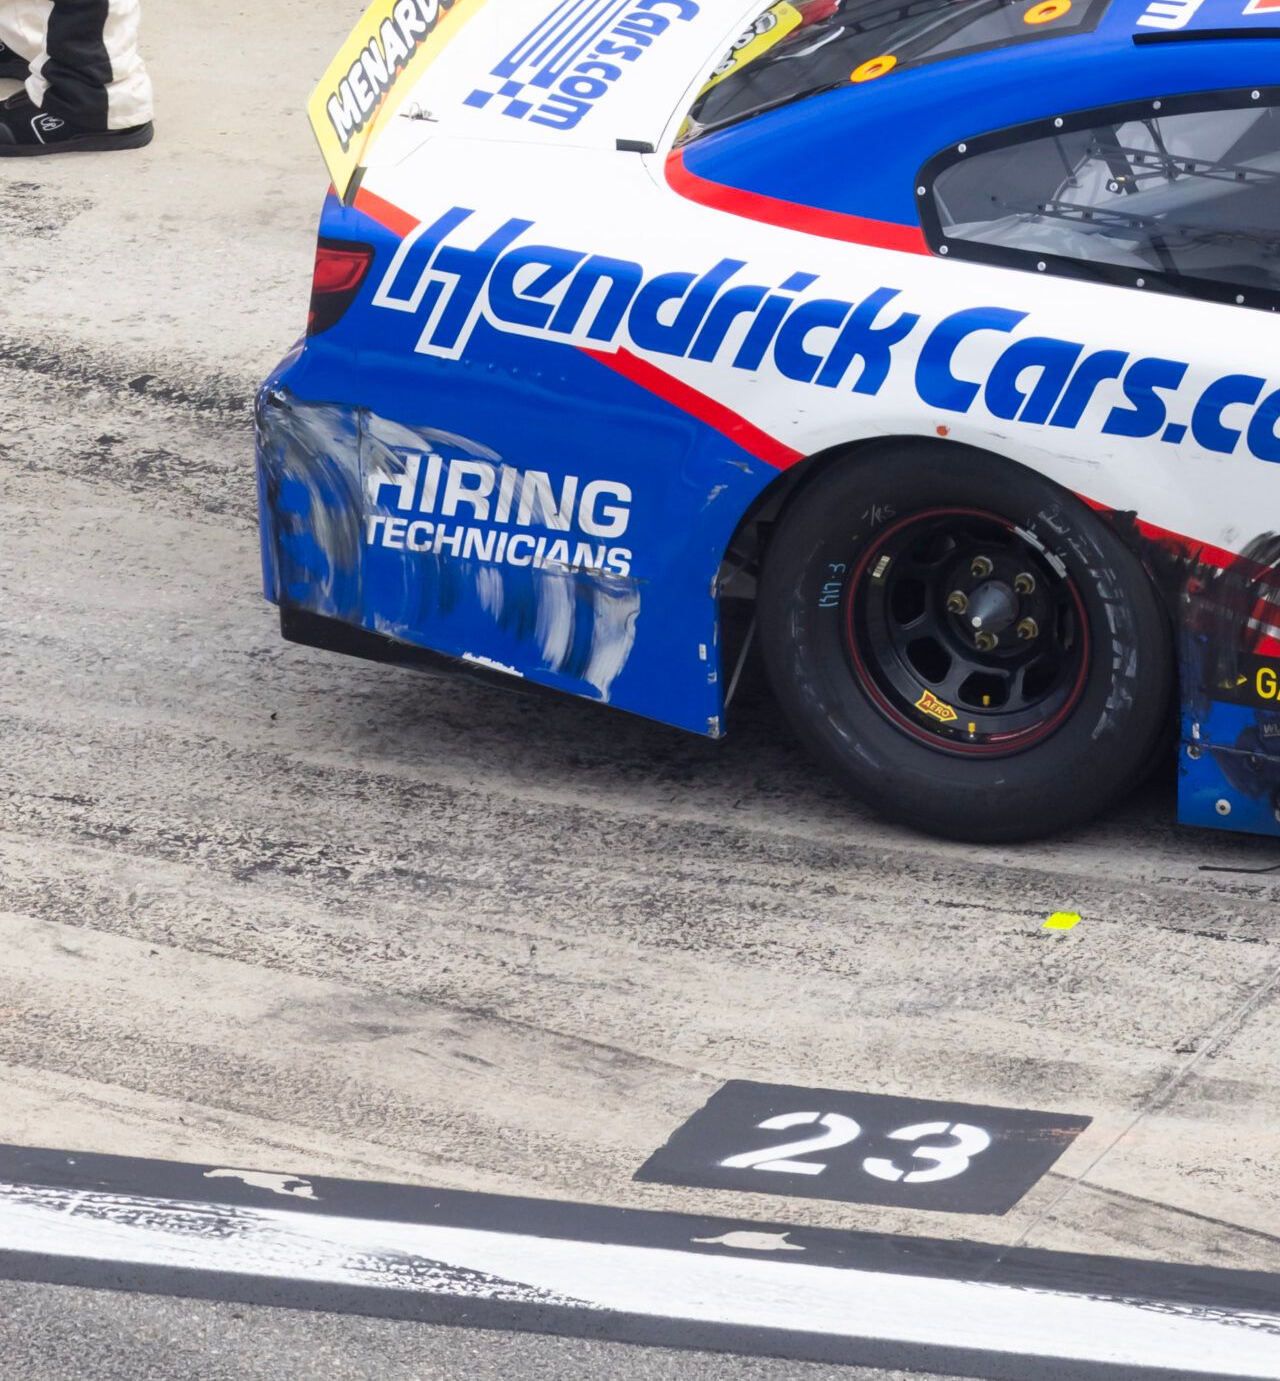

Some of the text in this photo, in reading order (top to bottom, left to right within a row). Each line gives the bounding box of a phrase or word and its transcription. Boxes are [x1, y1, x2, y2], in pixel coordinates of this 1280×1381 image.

[367, 454, 633, 539] HIRING
[363, 514, 633, 578] TECHNICIANS
[922, 699, 952, 718] AERO
[718, 1110, 992, 1184] 23
